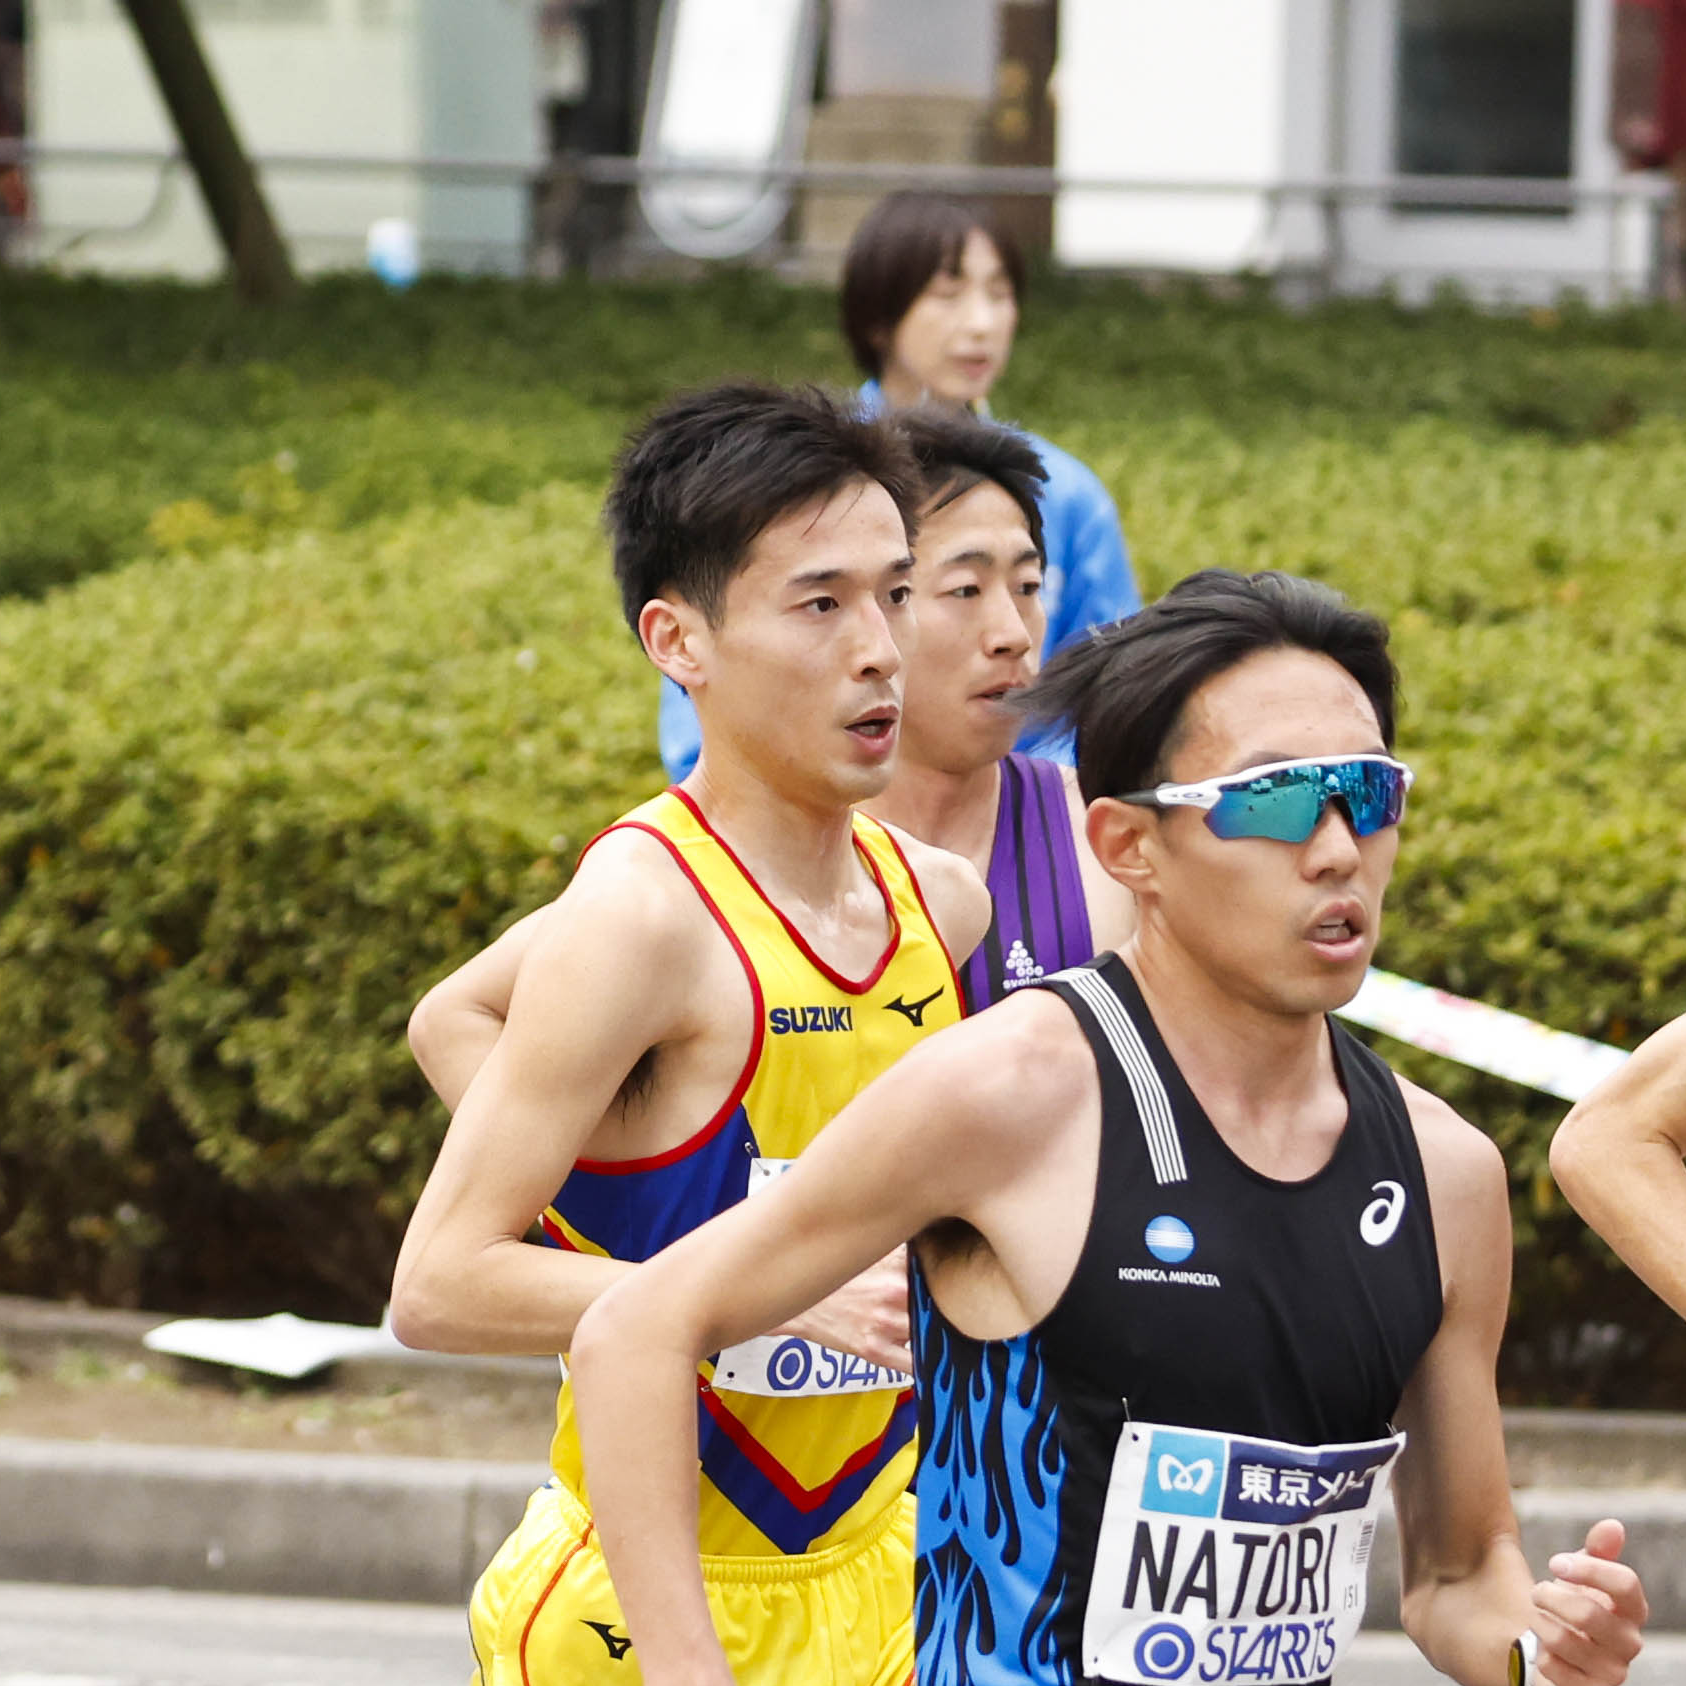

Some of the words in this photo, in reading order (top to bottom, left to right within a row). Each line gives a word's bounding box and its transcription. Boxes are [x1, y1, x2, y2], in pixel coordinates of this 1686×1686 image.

[769, 1006, 853, 1035] SUZUKI
[1118, 1267, 1168, 1282] KONICA
[1169, 1270, 1221, 1288] MINOLTA
[1122, 1520, 1338, 1619] NATORI
[1198, 1617, 1335, 1683] STARTS
